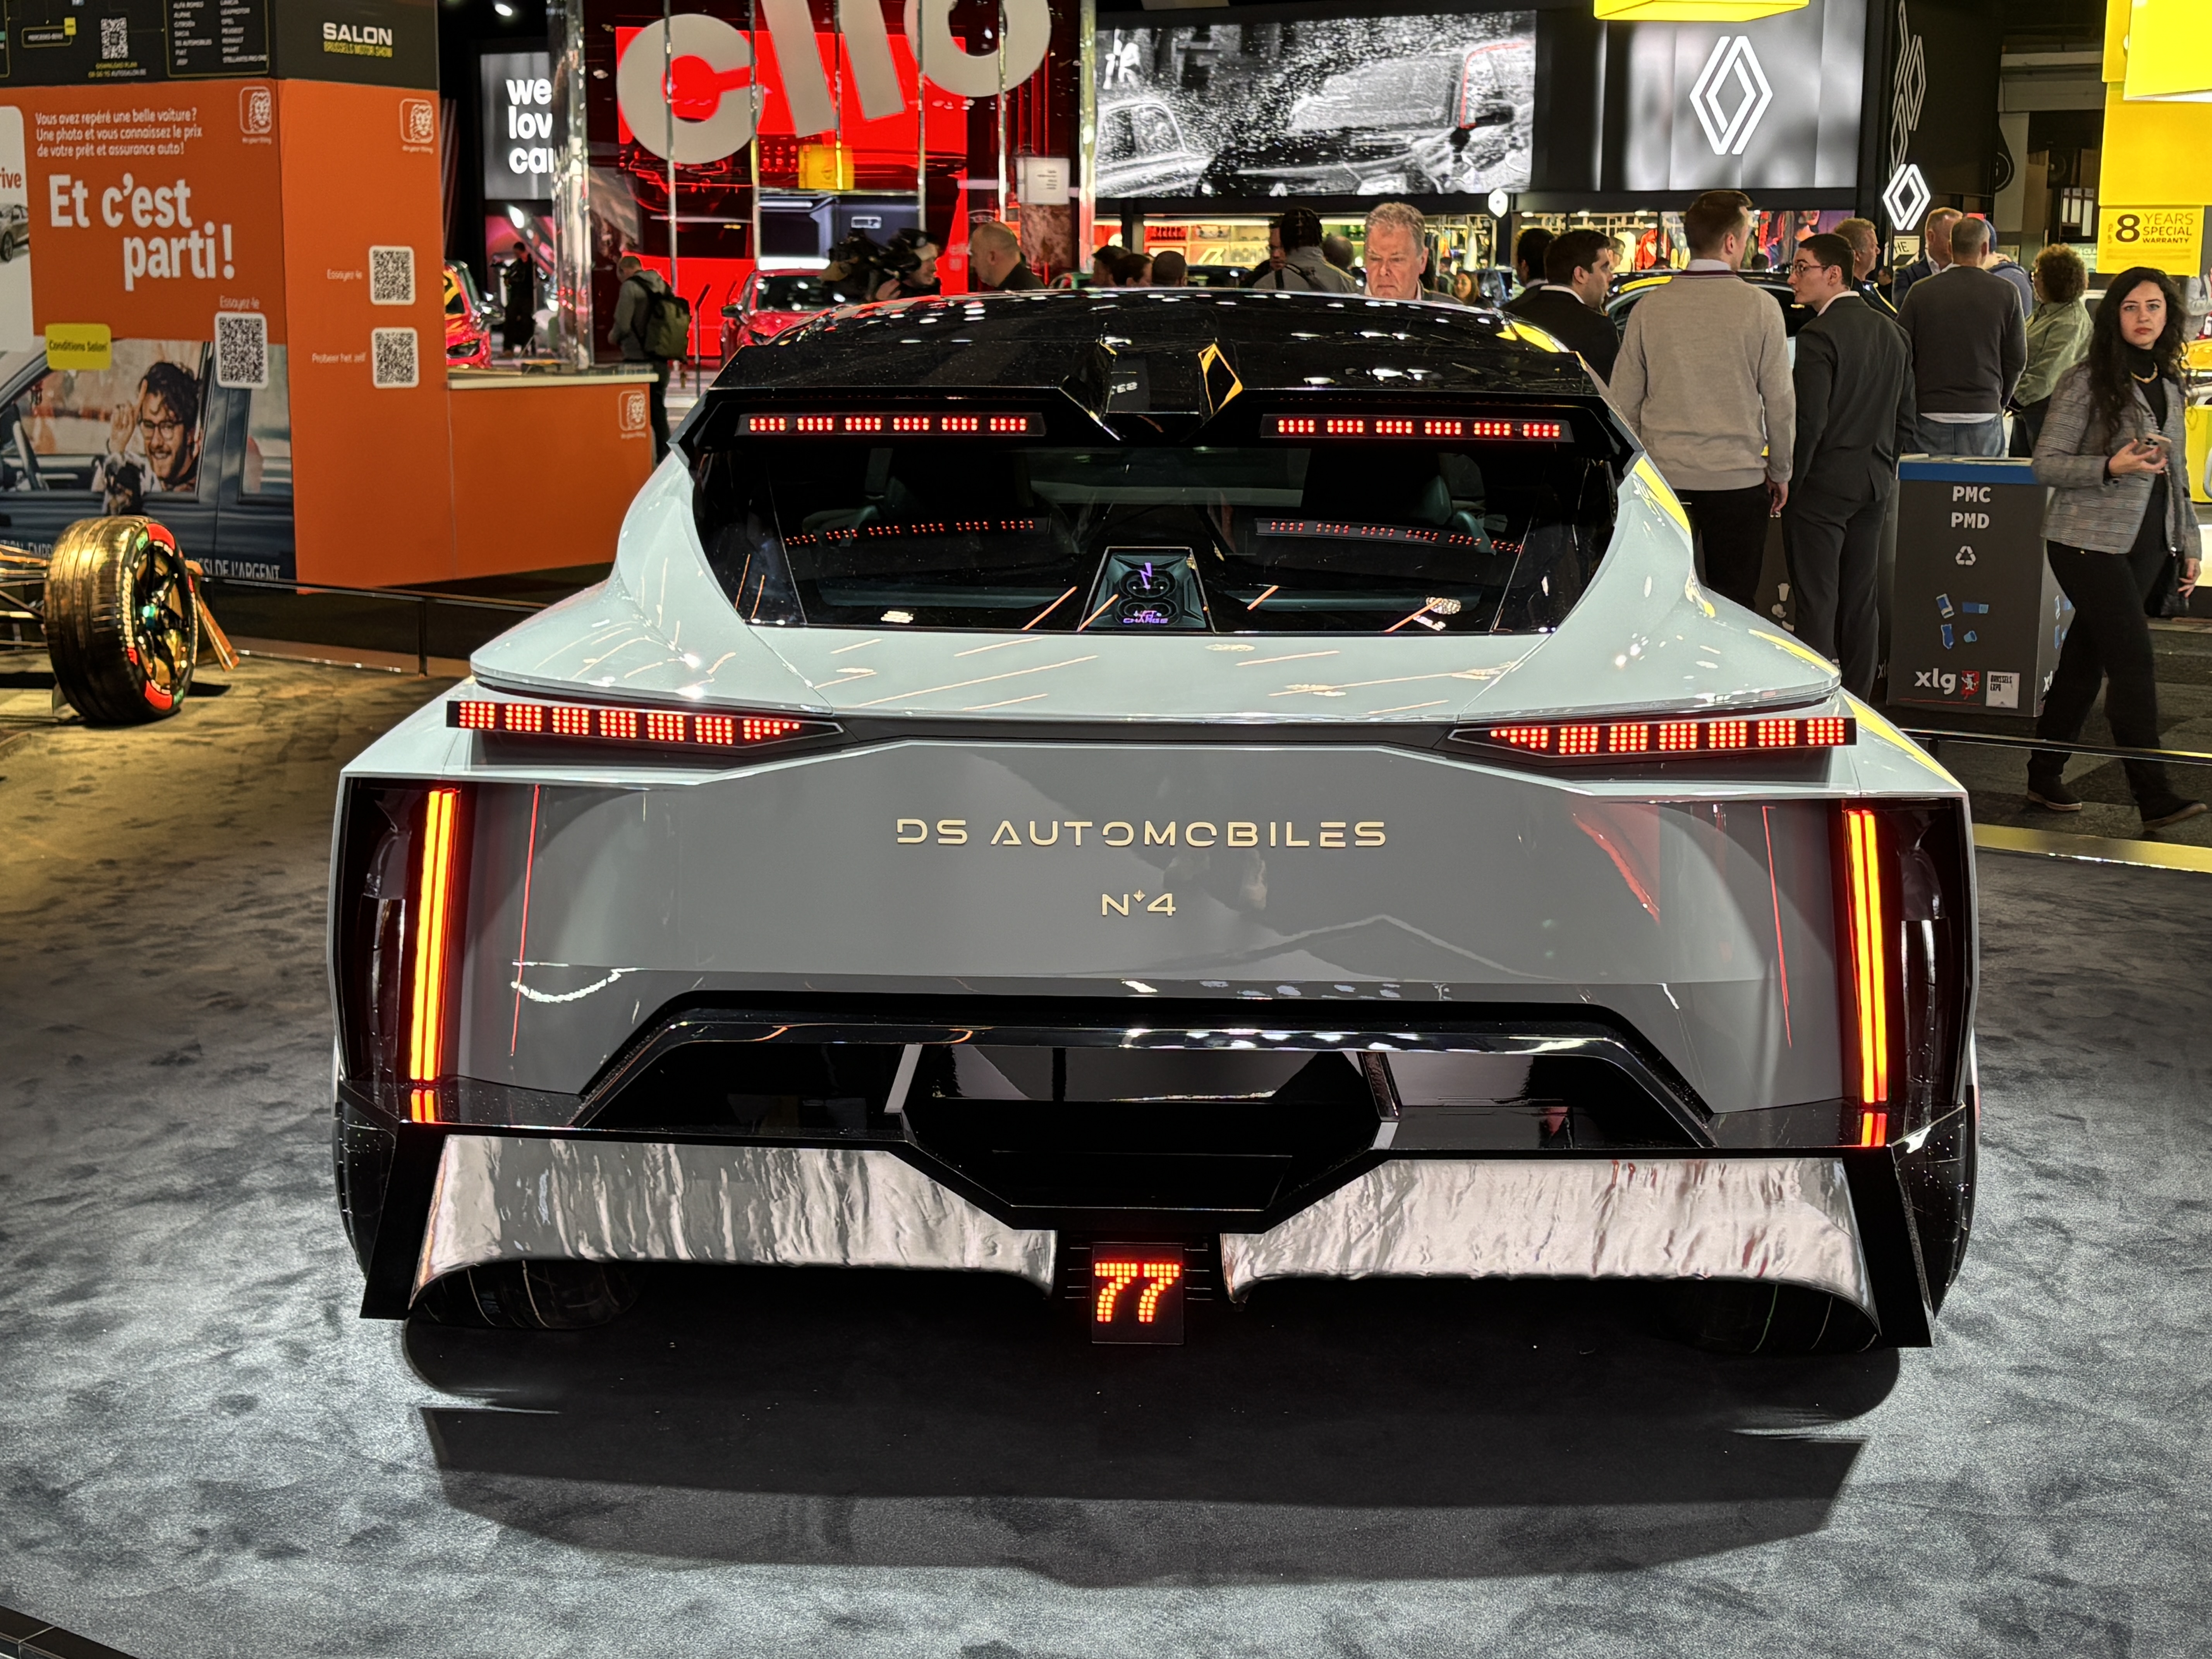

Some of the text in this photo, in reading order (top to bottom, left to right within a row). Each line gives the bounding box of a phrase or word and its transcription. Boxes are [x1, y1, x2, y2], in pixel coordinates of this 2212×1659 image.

[323, 22, 392, 46] SALON
[505, 79, 552, 105] we
[35, 112, 57, 125] Vous
[59, 114, 80, 125] avez
[82, 109, 111, 127] repéré
[113, 112, 131, 123] une
[132, 108, 155, 122] belle
[508, 105, 553, 139] lov
[36, 124, 203, 144] Une photo et vous connaissez le prix
[37, 143, 48, 157] de
[50, 144, 74, 157] votre
[76, 142, 95, 160] prêt
[97, 144, 106, 156] et
[108, 144, 155, 156] assurance
[0, 167, 22, 189] ive
[49, 174, 90, 228] Et
[2116, 214, 2140, 242] 8
[2144, 213, 2193, 225] YEARS
[2143, 227, 2192, 236] SPECIAL
[49, 339, 86, 352] Conditions
[1952, 486, 1991, 503] PMC
[1951, 513, 1990, 529] PMD
[1877, 659, 1887, 679] xl
[1914, 668, 1956, 695] xlg
[2043, 670, 2053, 692] xl
[897, 818, 1387, 848] DS AUTOMOBILES
[1094, 1262, 1180, 1322] 77
